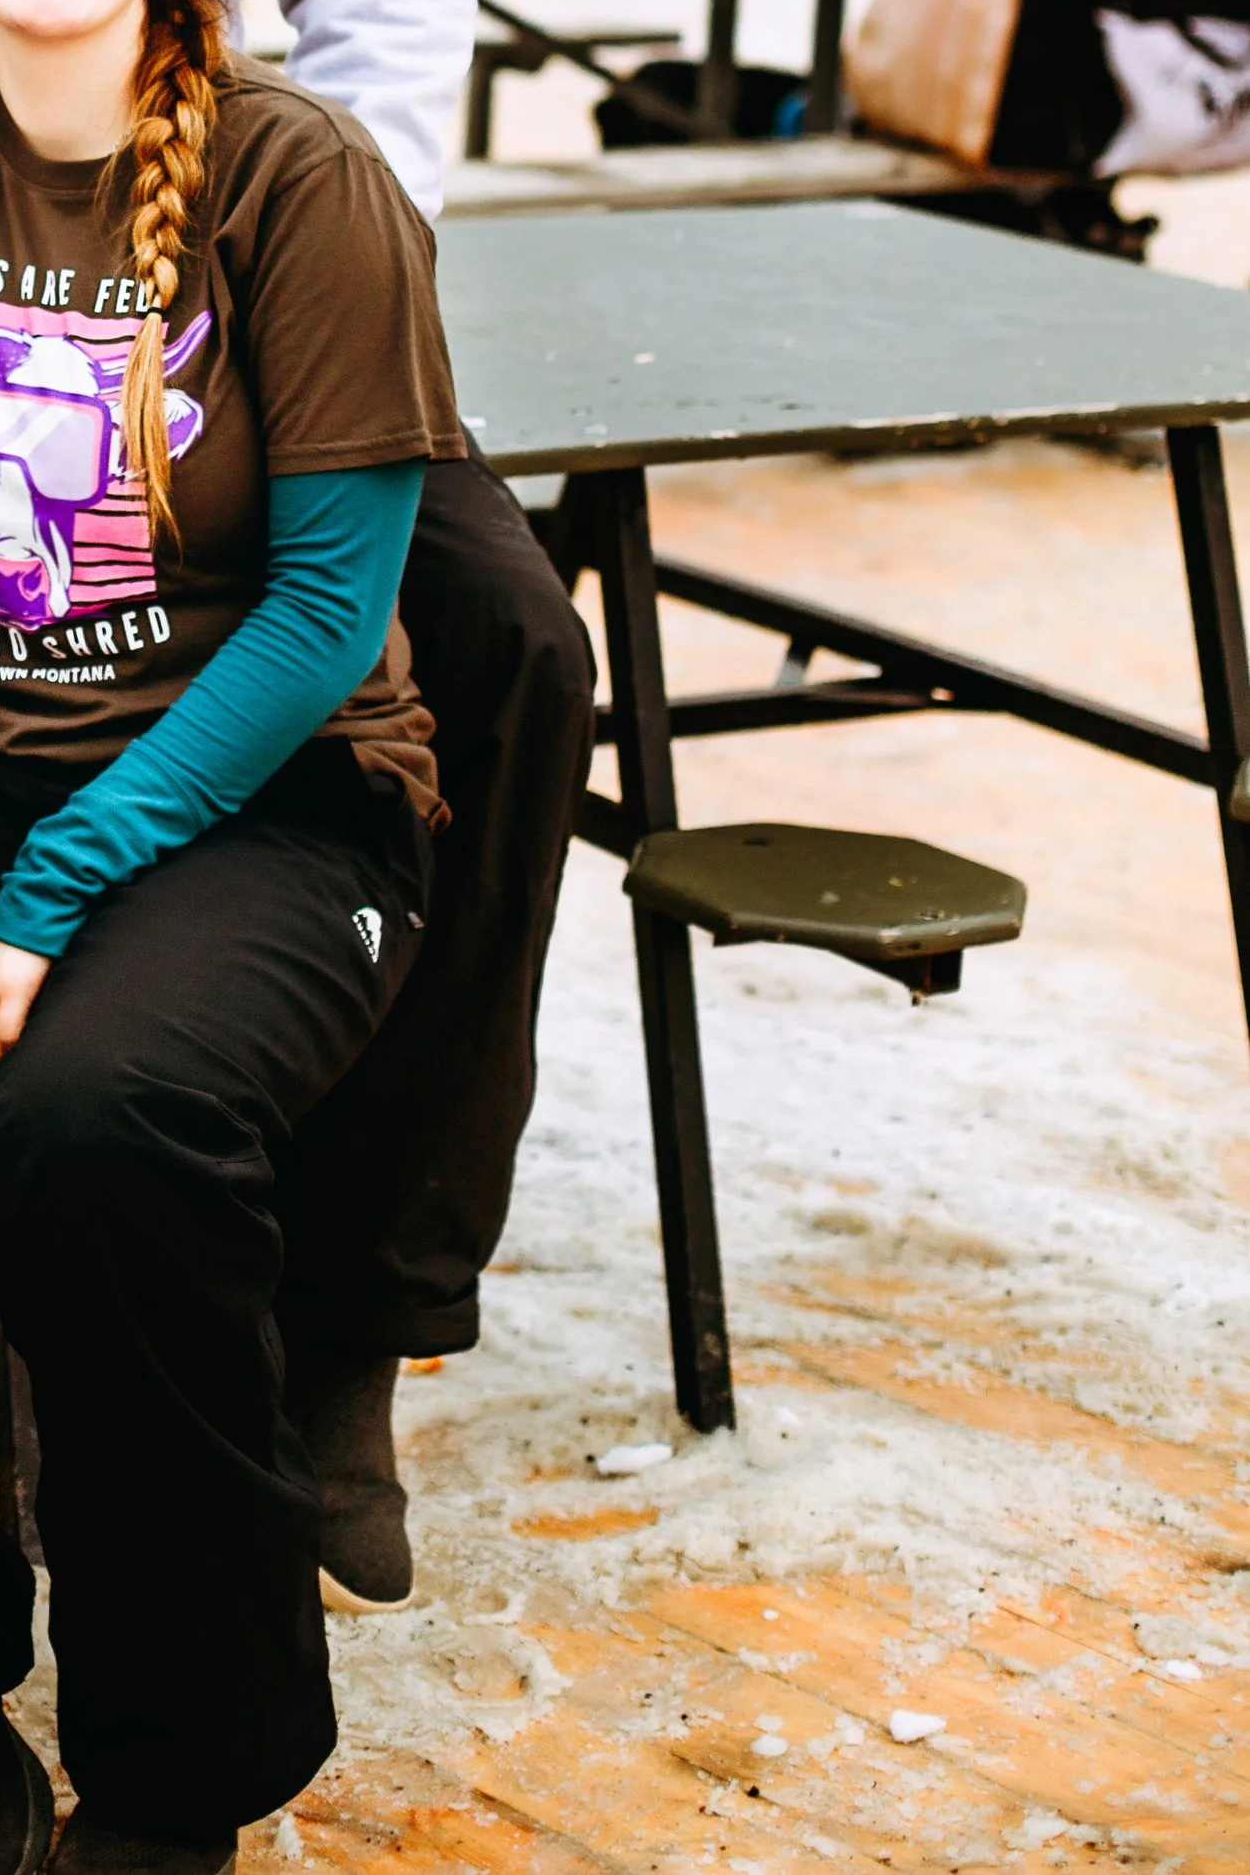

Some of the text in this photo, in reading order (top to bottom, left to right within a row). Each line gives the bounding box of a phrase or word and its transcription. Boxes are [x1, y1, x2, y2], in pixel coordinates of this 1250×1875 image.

[21, 265, 75, 306] ARE
[42, 606, 171, 660] SHRED
[32, 664, 116, 684] MONTANA
